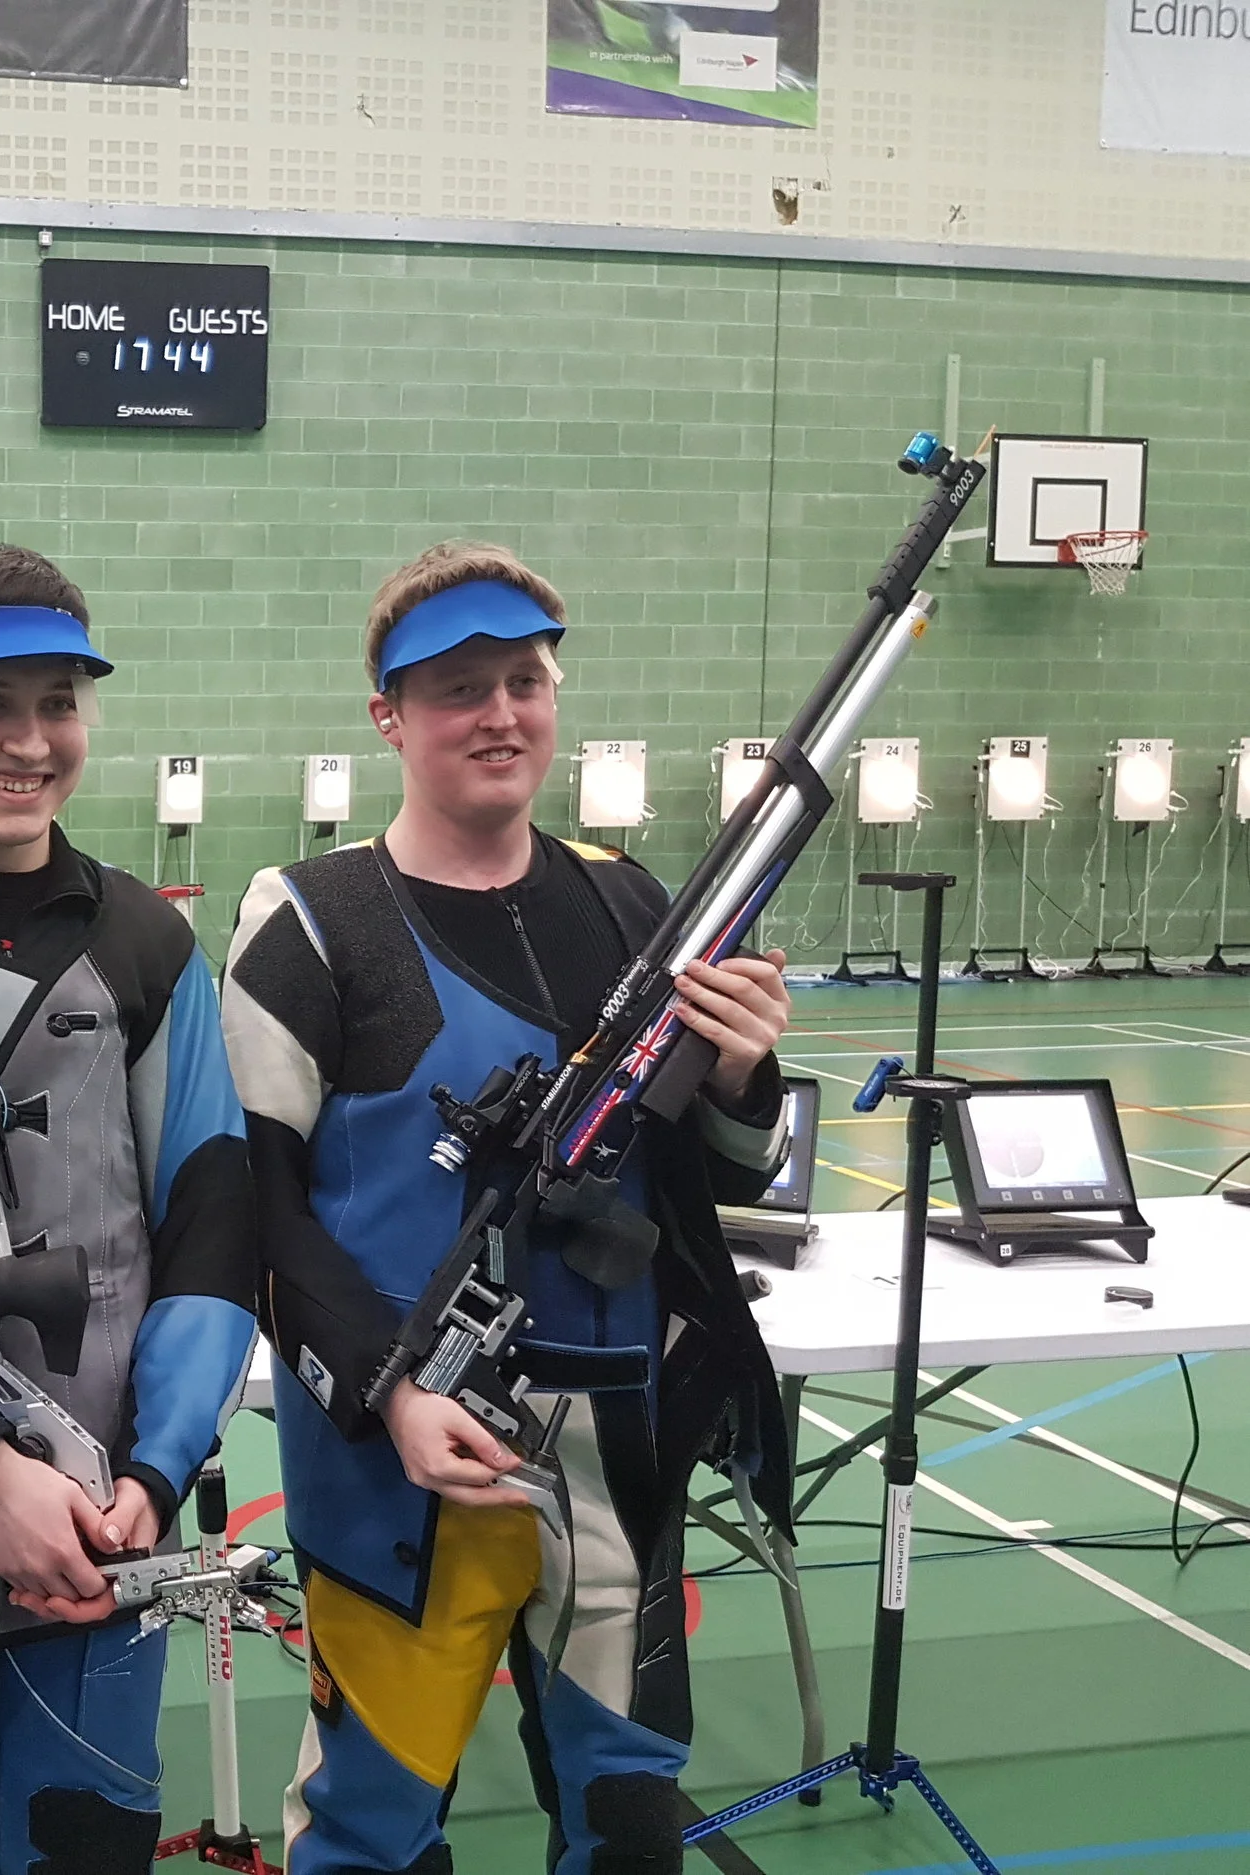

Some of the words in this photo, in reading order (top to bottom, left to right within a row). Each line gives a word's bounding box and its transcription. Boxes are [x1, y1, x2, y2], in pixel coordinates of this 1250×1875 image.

[588, 49, 598, 59] in
[599, 50, 651, 64] partnership
[652, 54, 674, 64] with
[48, 304, 126, 332] HOME
[169, 308, 268, 334] GUESTS
[116, 405, 193, 427] STRAMATEL
[949, 469, 975, 507] 9003
[606, 743, 621, 754] 22
[746, 745, 762, 757] 23
[886, 745, 899, 756] 24
[1013, 740, 1028, 752] 25
[1139, 742, 1152, 753] 26
[174, 760, 192, 774] 19
[321, 759, 338, 773] 20
[602, 983, 630, 1021] 9003
[622, 958, 643, 986] Premium
[541, 1064, 573, 1111] STABILISATOR
